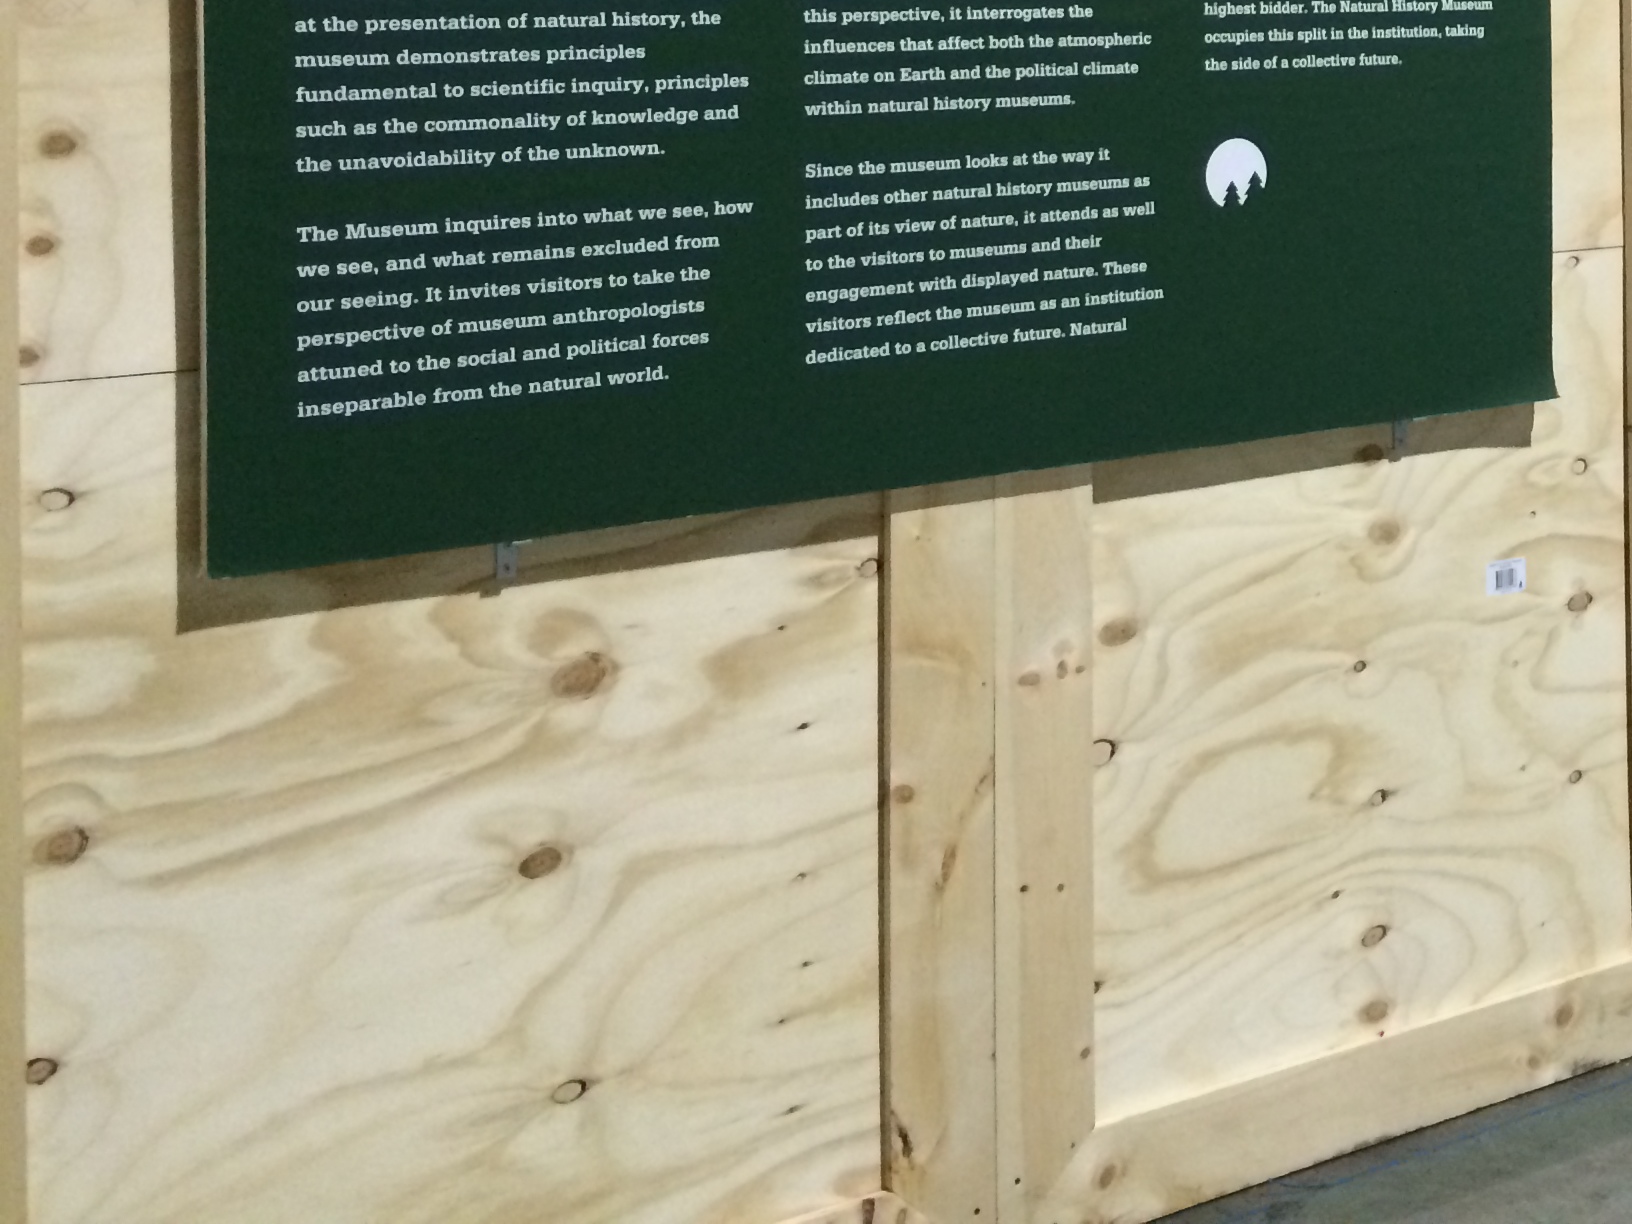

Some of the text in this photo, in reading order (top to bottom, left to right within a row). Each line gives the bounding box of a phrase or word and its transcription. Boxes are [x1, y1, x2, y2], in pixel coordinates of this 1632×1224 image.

[294, 10, 721, 35] at the presentation of natural history, the
[803, 4, 1093, 25] this perspective, it interrogates the
[1203, 1, 1256, 18] highest
[1259, 0, 1308, 14] bidder.
[1311, 0, 1336, 13] The
[1339, 0, 1389, 13] Natural
[804, 31, 1152, 54] influences that affect both the atmospheric
[1204, 23, 1484, 45] occupies this split in the institution, taking
[294, 43, 646, 67] museum demonstrates principles
[1204, 52, 1402, 71] the side of a collective future.
[295, 72, 749, 102] fundamental to scientific inquiry, principles
[804, 94, 1075, 116] within natural history museums.
[295, 142, 665, 173] the unavoidability of the unknown.
[805, 147, 1110, 178] Since the museum looks at the way it
[805, 176, 1150, 209] includes other natural history museums as
[296, 200, 754, 242] The Museum inquires into what we see, how
[805, 260, 1148, 304] engagement with displayed nature. These
[805, 287, 1164, 333] visitors reflect the museum as an institution
[805, 317, 1127, 364] dedicated to a collective future. Natural
[297, 365, 669, 418] inseparable from the natural world.
